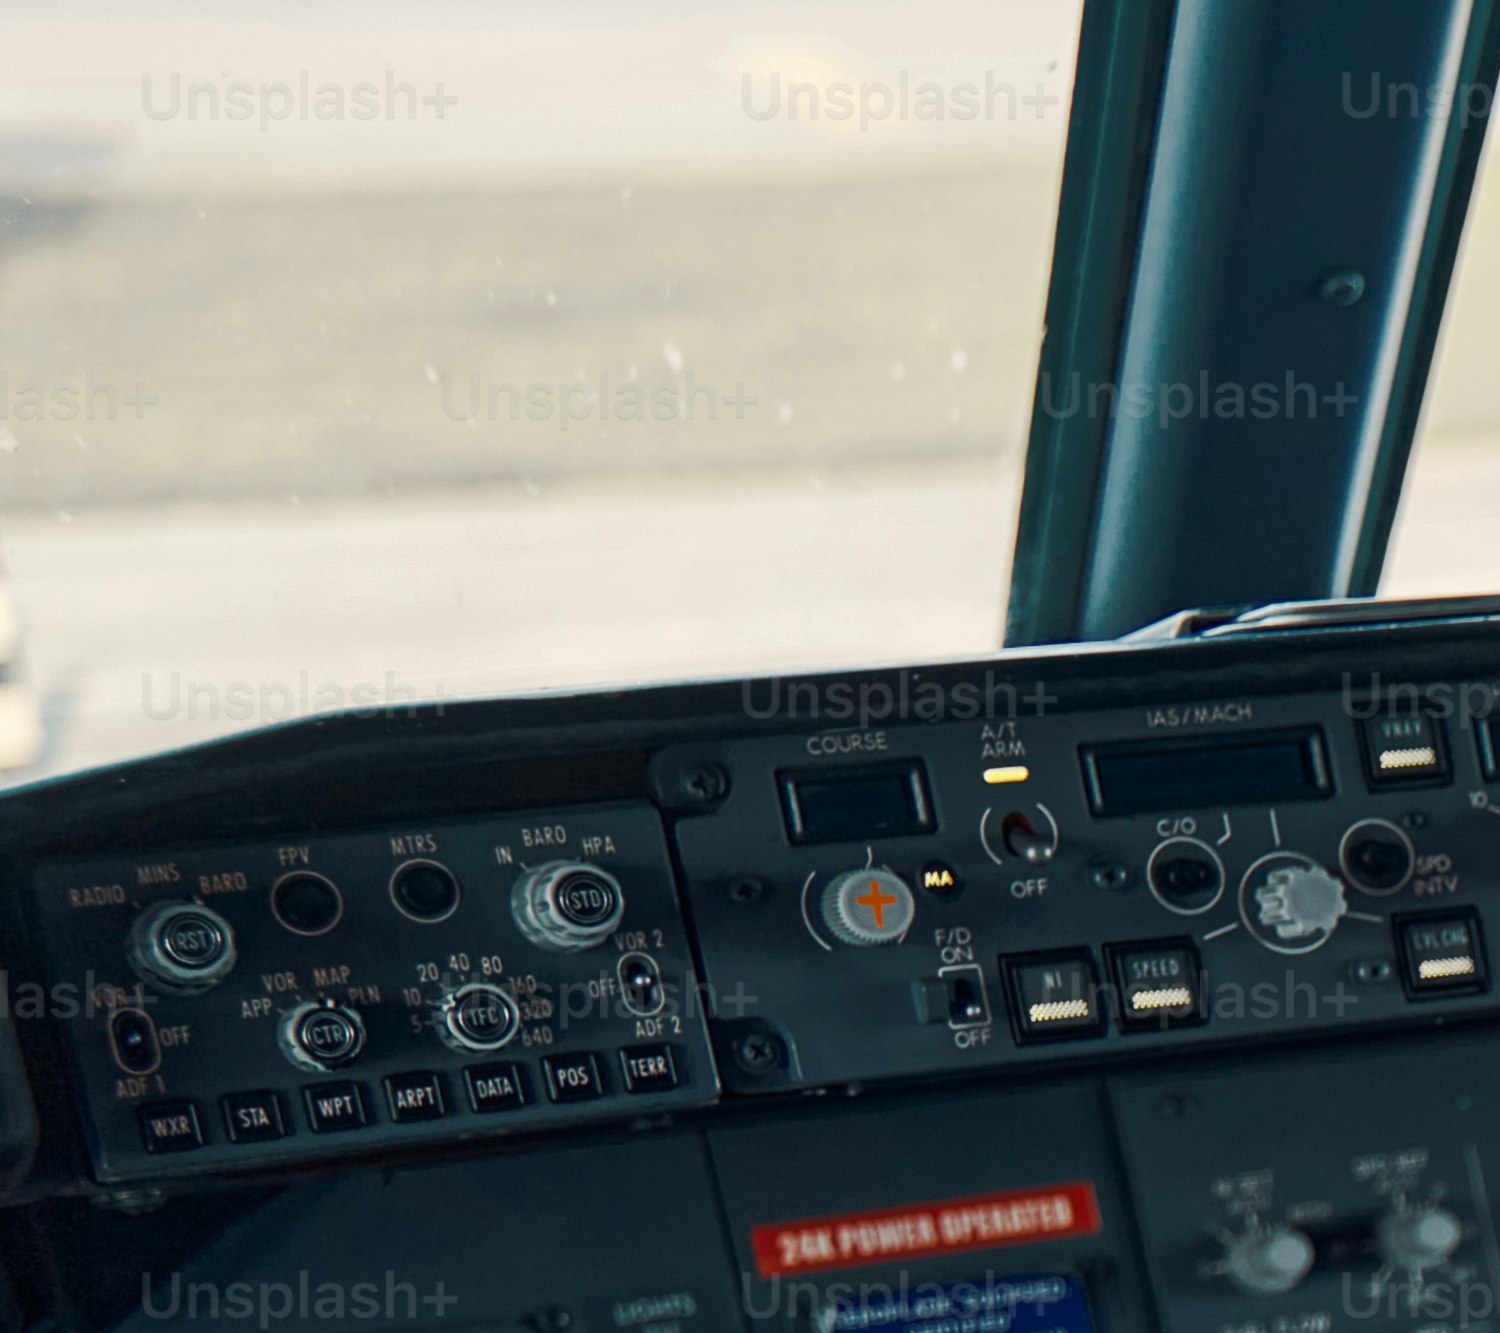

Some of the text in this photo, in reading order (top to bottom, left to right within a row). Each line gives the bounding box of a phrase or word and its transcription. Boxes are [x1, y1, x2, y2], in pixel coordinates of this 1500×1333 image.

[1145, 704, 1253, 729] IAS/MACH
[980, 721, 1018, 742] A/T
[806, 732, 889, 756] COURSE
[981, 740, 1026, 760] ARM
[1468, 789, 1489, 810] 10
[521, 825, 568, 848] BARO
[1156, 815, 1197, 838] C/O
[278, 847, 311, 866] FPV
[390, 834, 437, 857] MTRS
[494, 846, 514, 865] IN
[582, 836, 617, 857] HPA
[136, 863, 182, 886] MINS
[1416, 853, 1451, 875] SPD
[199, 872, 248, 895] BARO
[924, 870, 955, 889] MA
[1010, 877, 1050, 899] OFF
[69, 885, 127, 909] RADIO
[570, 888, 602, 912] STD
[177, 930, 209, 951] RST
[613, 928, 666, 951] VOR 2
[934, 927, 973, 947] F/D
[448, 952, 471, 973] 40
[480, 955, 504, 976] 80
[940, 945, 975, 965] ON
[313, 966, 351, 987] MAP
[416, 962, 440, 983] 20
[1131, 958, 1181, 980] SPEED
[262, 970, 298, 992] VOR
[588, 979, 618, 1000] OFF
[241, 998, 273, 1020] APP
[403, 988, 422, 1008] 10
[469, 1005, 499, 1028] TFC
[635, 1015, 683, 1039] ADF 2
[160, 1025, 191, 1047] OFF
[312, 1023, 346, 1044] CTR
[520, 1026, 554, 1047] 640
[954, 1028, 992, 1049] OFF
[557, 1064, 590, 1088] POS
[630, 1055, 668, 1079] TERR
[116, 1079, 149, 1099] ADF
[396, 1085, 436, 1110] ARPT
[476, 1077, 515, 1101] DATA
[238, 1105, 271, 1129] STA
[317, 1095, 354, 1119] WPT
[151, 1115, 191, 1138] WXR
[836, 1212, 938, 1256] POWER
[938, 1194, 1076, 1246] OPERATED
